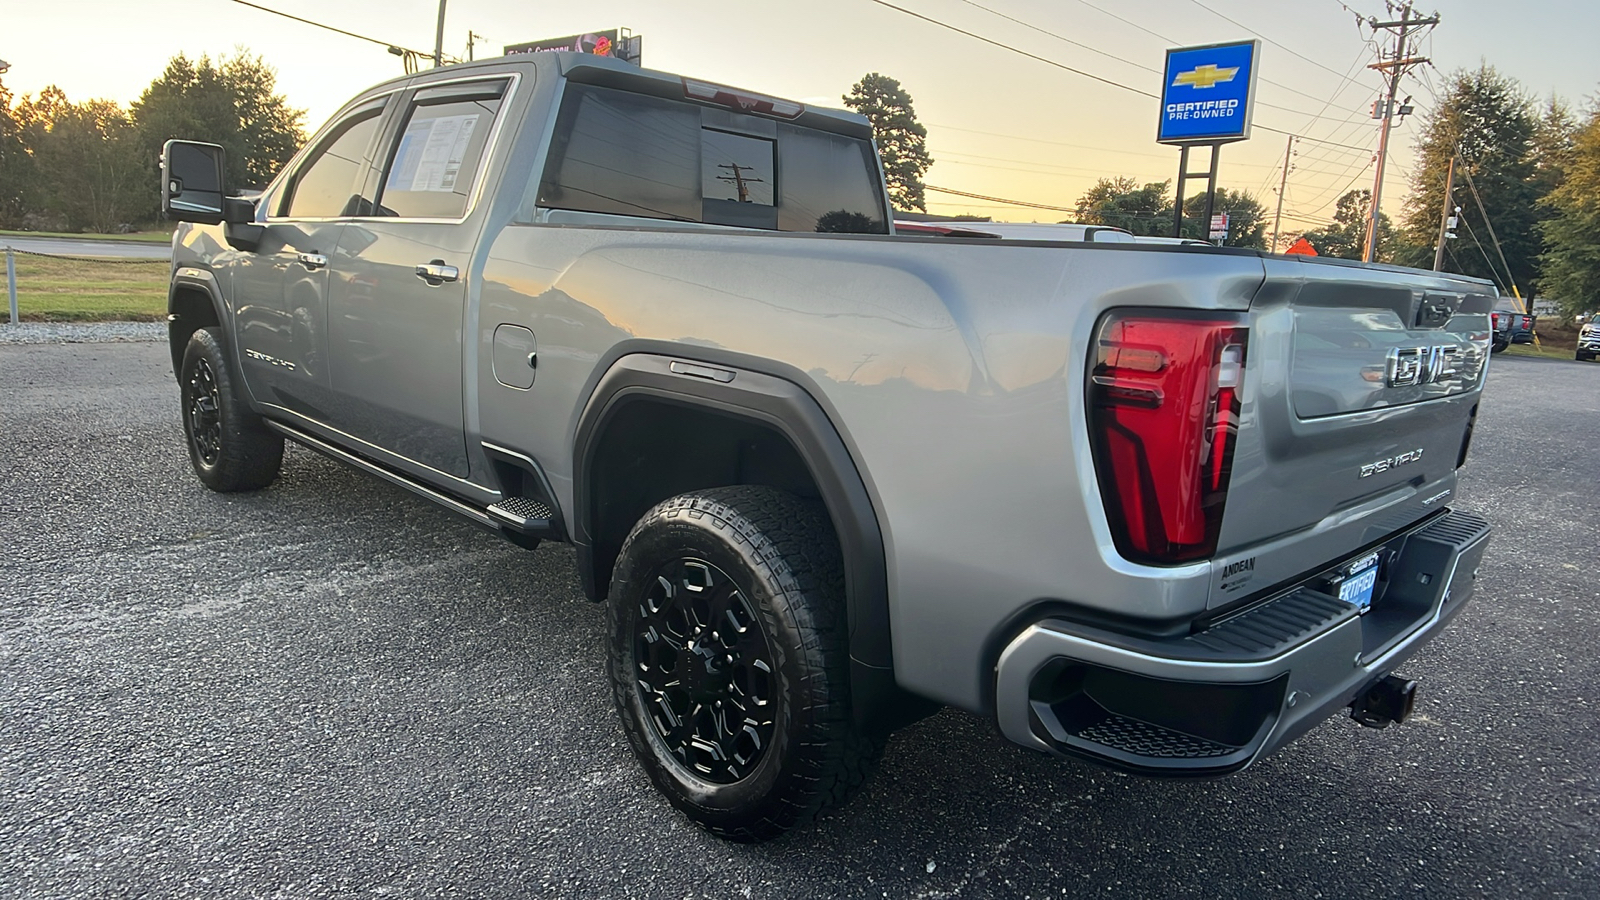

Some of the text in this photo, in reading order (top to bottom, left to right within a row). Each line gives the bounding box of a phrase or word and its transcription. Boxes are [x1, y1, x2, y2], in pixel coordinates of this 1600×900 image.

[1166, 98, 1239, 113] CERTIFIED
[1169, 108, 1234, 120] PRE-OWNED
[1221, 556, 1256, 580] ANDEAN
[1339, 570, 1377, 601] ERTIFIED
